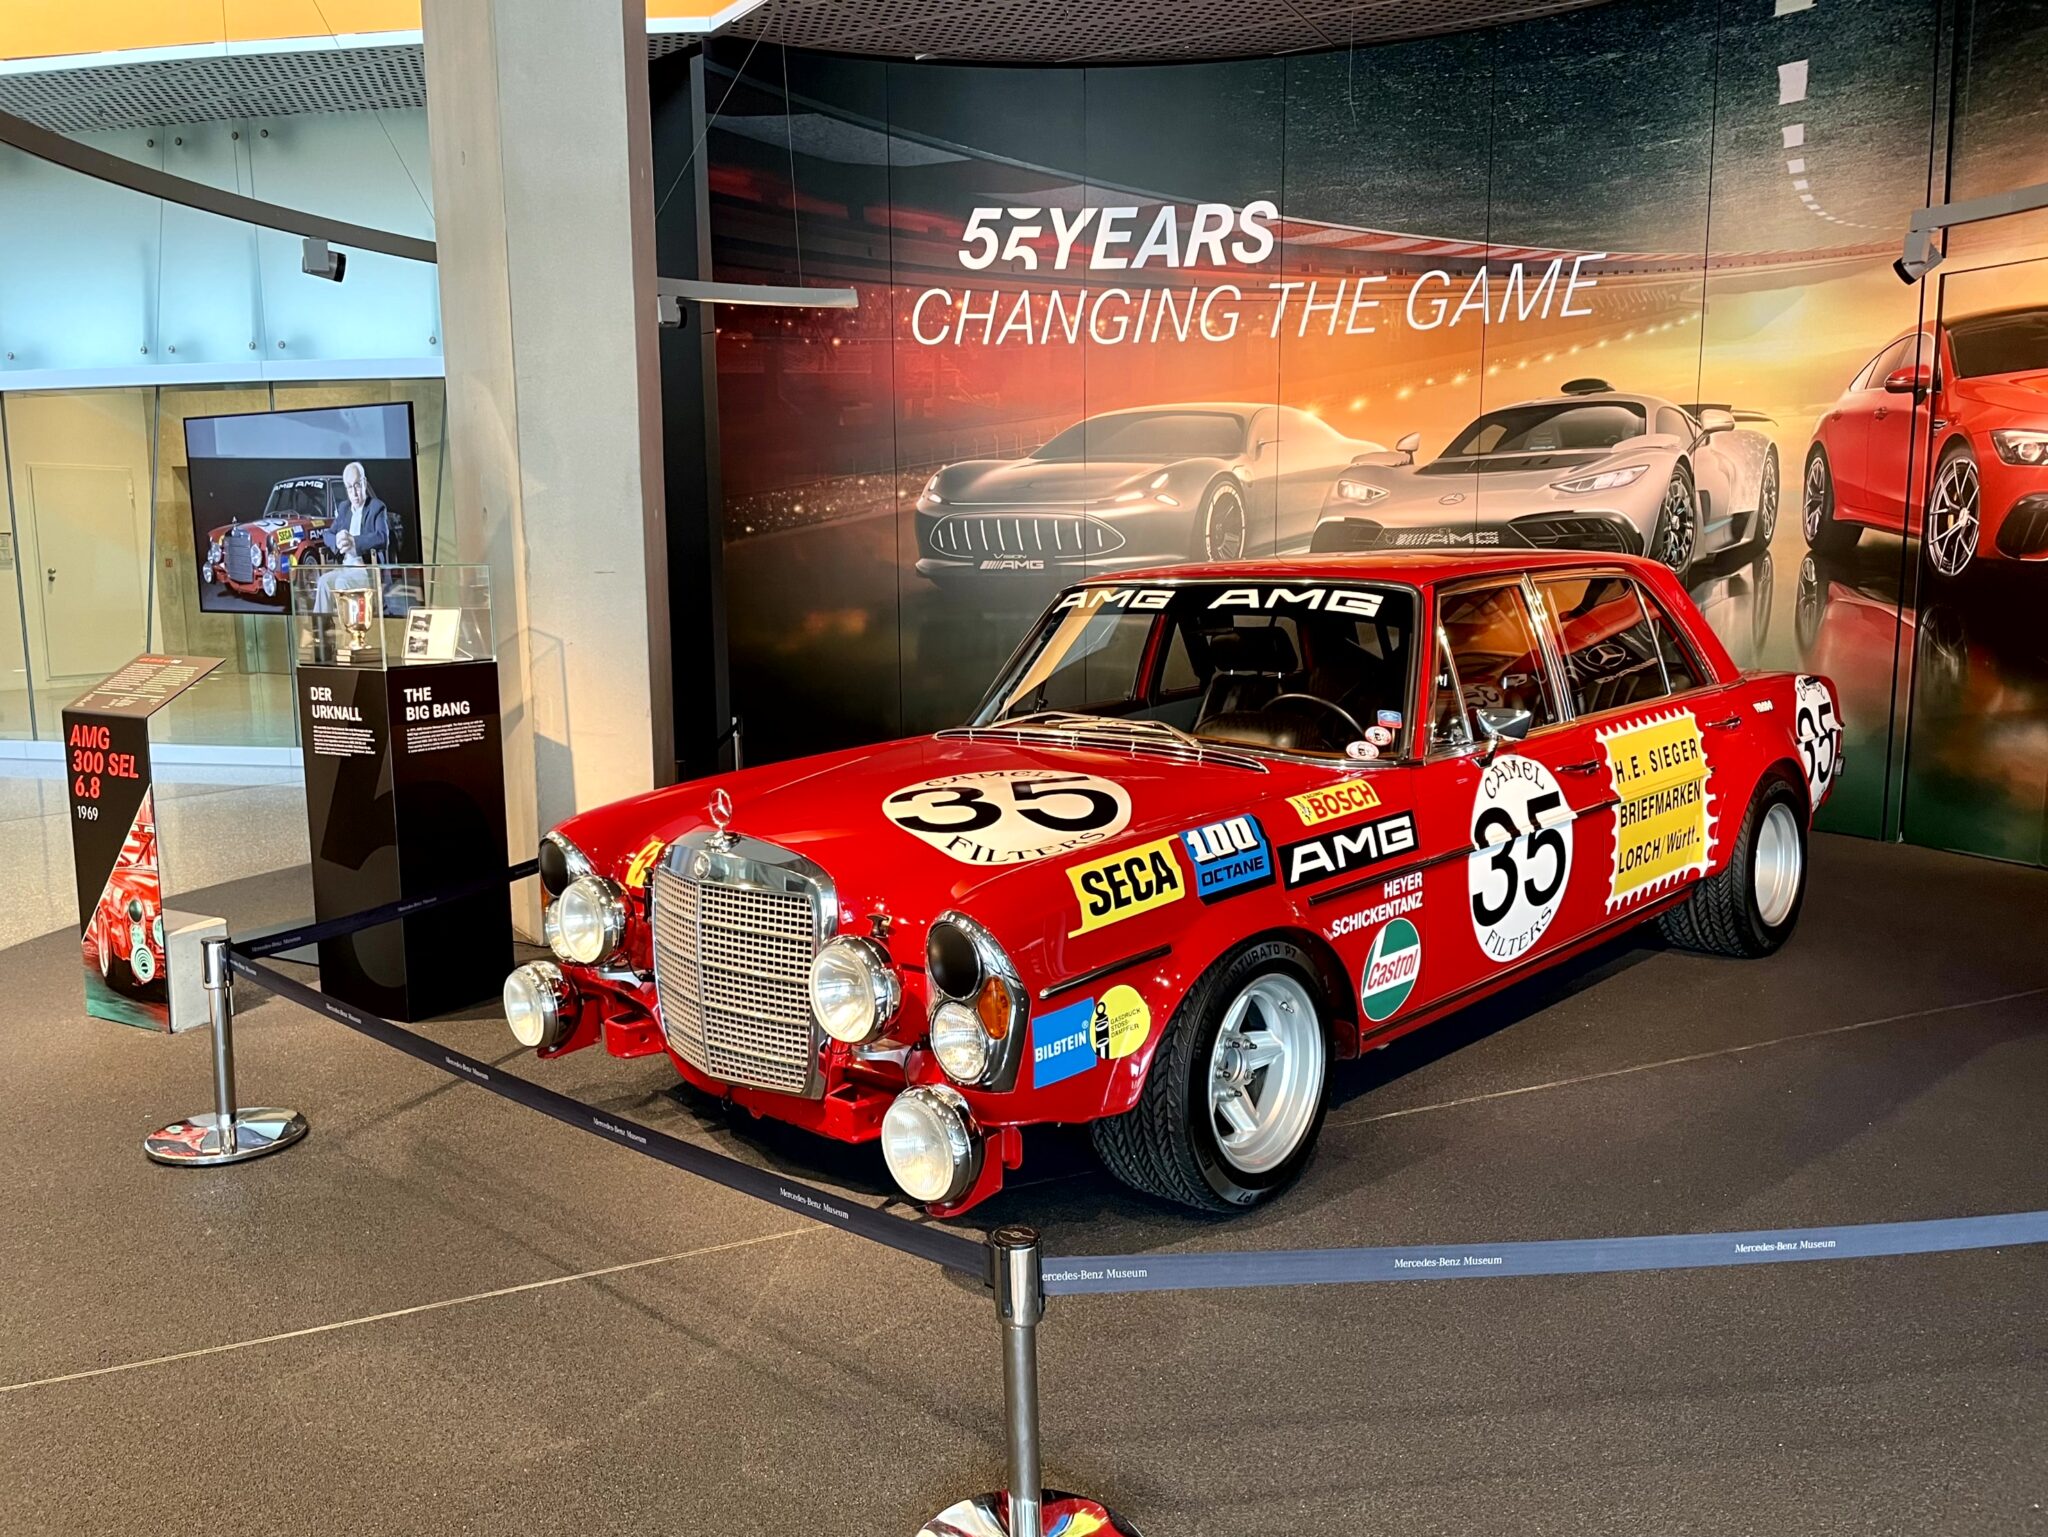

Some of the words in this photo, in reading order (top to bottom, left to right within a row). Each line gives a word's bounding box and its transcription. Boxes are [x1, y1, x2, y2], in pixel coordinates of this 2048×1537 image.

[911, 284, 1242, 346] CHANGING
[1268, 275, 1388, 338] THE
[1405, 252, 1607, 331] GAME
[1000, 560, 1044, 570] AMG
[1052, 588, 1176, 614] AMG
[1207, 588, 1384, 617] AMG
[310, 686, 332, 702] DER
[404, 686, 432, 703] THE
[311, 704, 362, 722] URKNALL
[406, 704, 430, 721] BIG
[433, 701, 470, 718] BANG
[70, 724, 110, 750] AMG
[72, 749, 104, 774] 300
[107, 752, 139, 779] SEL
[1614, 755, 1646, 784] H.E.
[1649, 738, 1699, 773] SIEGER
[75, 774, 100, 799] 6.8
[926, 770, 1054, 788] CAMEL
[1484, 760, 1545, 799] CAMEL
[77, 804, 98, 821] 1969
[889, 776, 1119, 833] 35
[1307, 783, 1377, 819] BOSCH
[1620, 779, 1701, 828] BRIEFMARKEN
[945, 831, 1106, 863] FILTERS
[1187, 816, 1258, 864] 100
[1290, 815, 1415, 884] AMG
[1201, 856, 1264, 888] OCTANE
[1472, 791, 1566, 927] 35
[1080, 850, 1179, 917] SECA
[1384, 871, 1423, 899] HEYER
[1331, 891, 1423, 938] SCHICKENTANZ
[1485, 906, 1552, 957] FILTERS
[1285, 945, 1297, 958] P7
[1367, 948, 1419, 990] Castrol
[780, 1186, 821, 1209] Mercedes-Benz
[823, 1202, 849, 1219] Museum
[1734, 1241, 1797, 1253] Mercedes-Benz
[1799, 1239, 1836, 1249] Museum
[1041, 1269, 1103, 1281] ercedes-Benz
[1106, 1268, 1148, 1279] Museum
[1394, 1257, 1461, 1268] Mercedes-Benz
[1463, 1256, 1502, 1266] Museum
